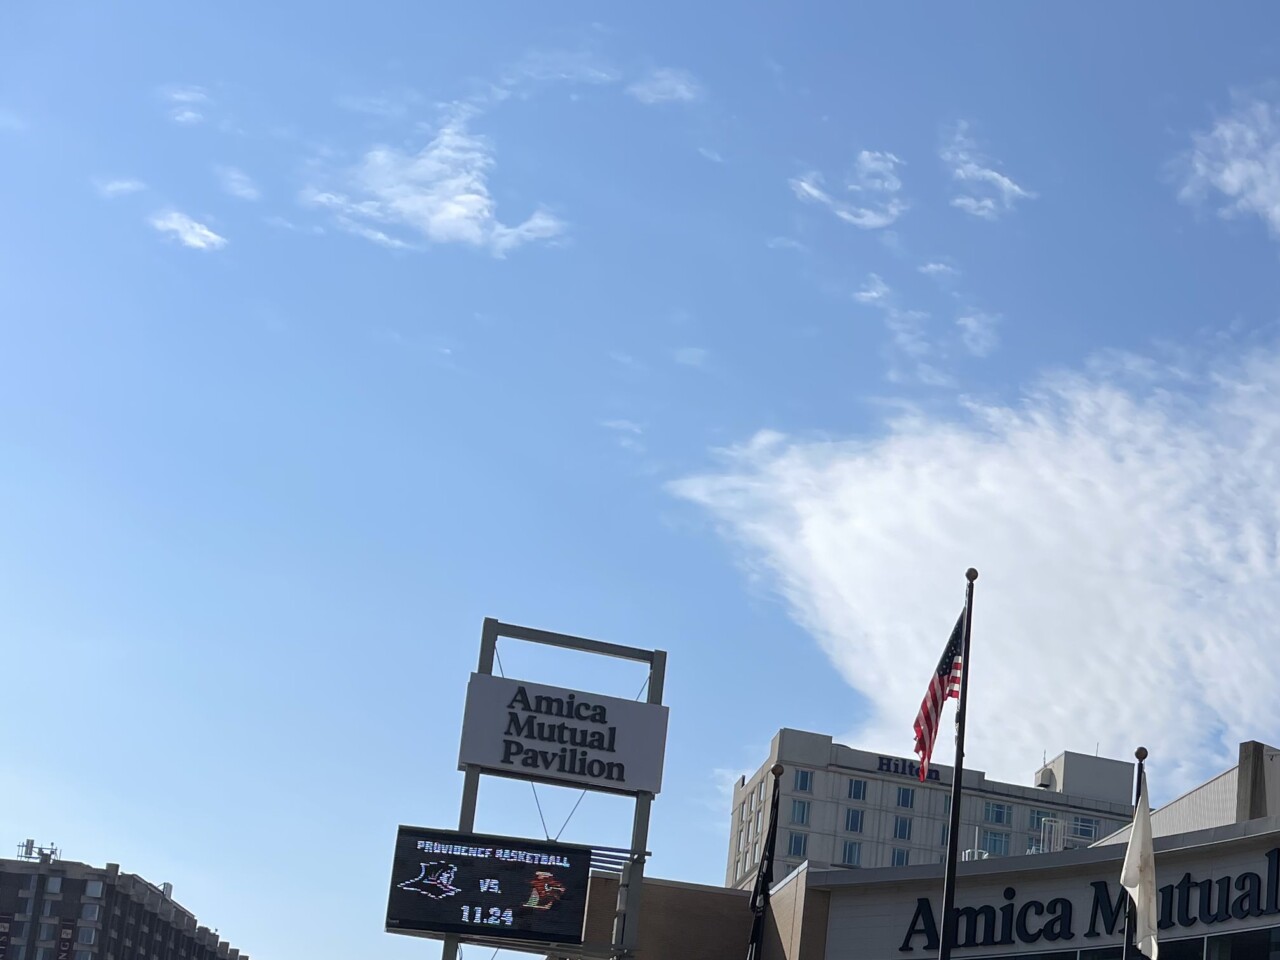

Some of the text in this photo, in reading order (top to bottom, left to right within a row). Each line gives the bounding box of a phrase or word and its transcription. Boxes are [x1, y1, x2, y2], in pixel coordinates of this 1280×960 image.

[506, 685, 608, 725] Amica
[503, 711, 617, 753] Mutual
[500, 738, 626, 782] Pavilion
[416, 840, 571, 868] PROVIDENCE BASKETBALL
[460, 904, 514, 926] 11.24
[899, 886, 1075, 952] Amica
